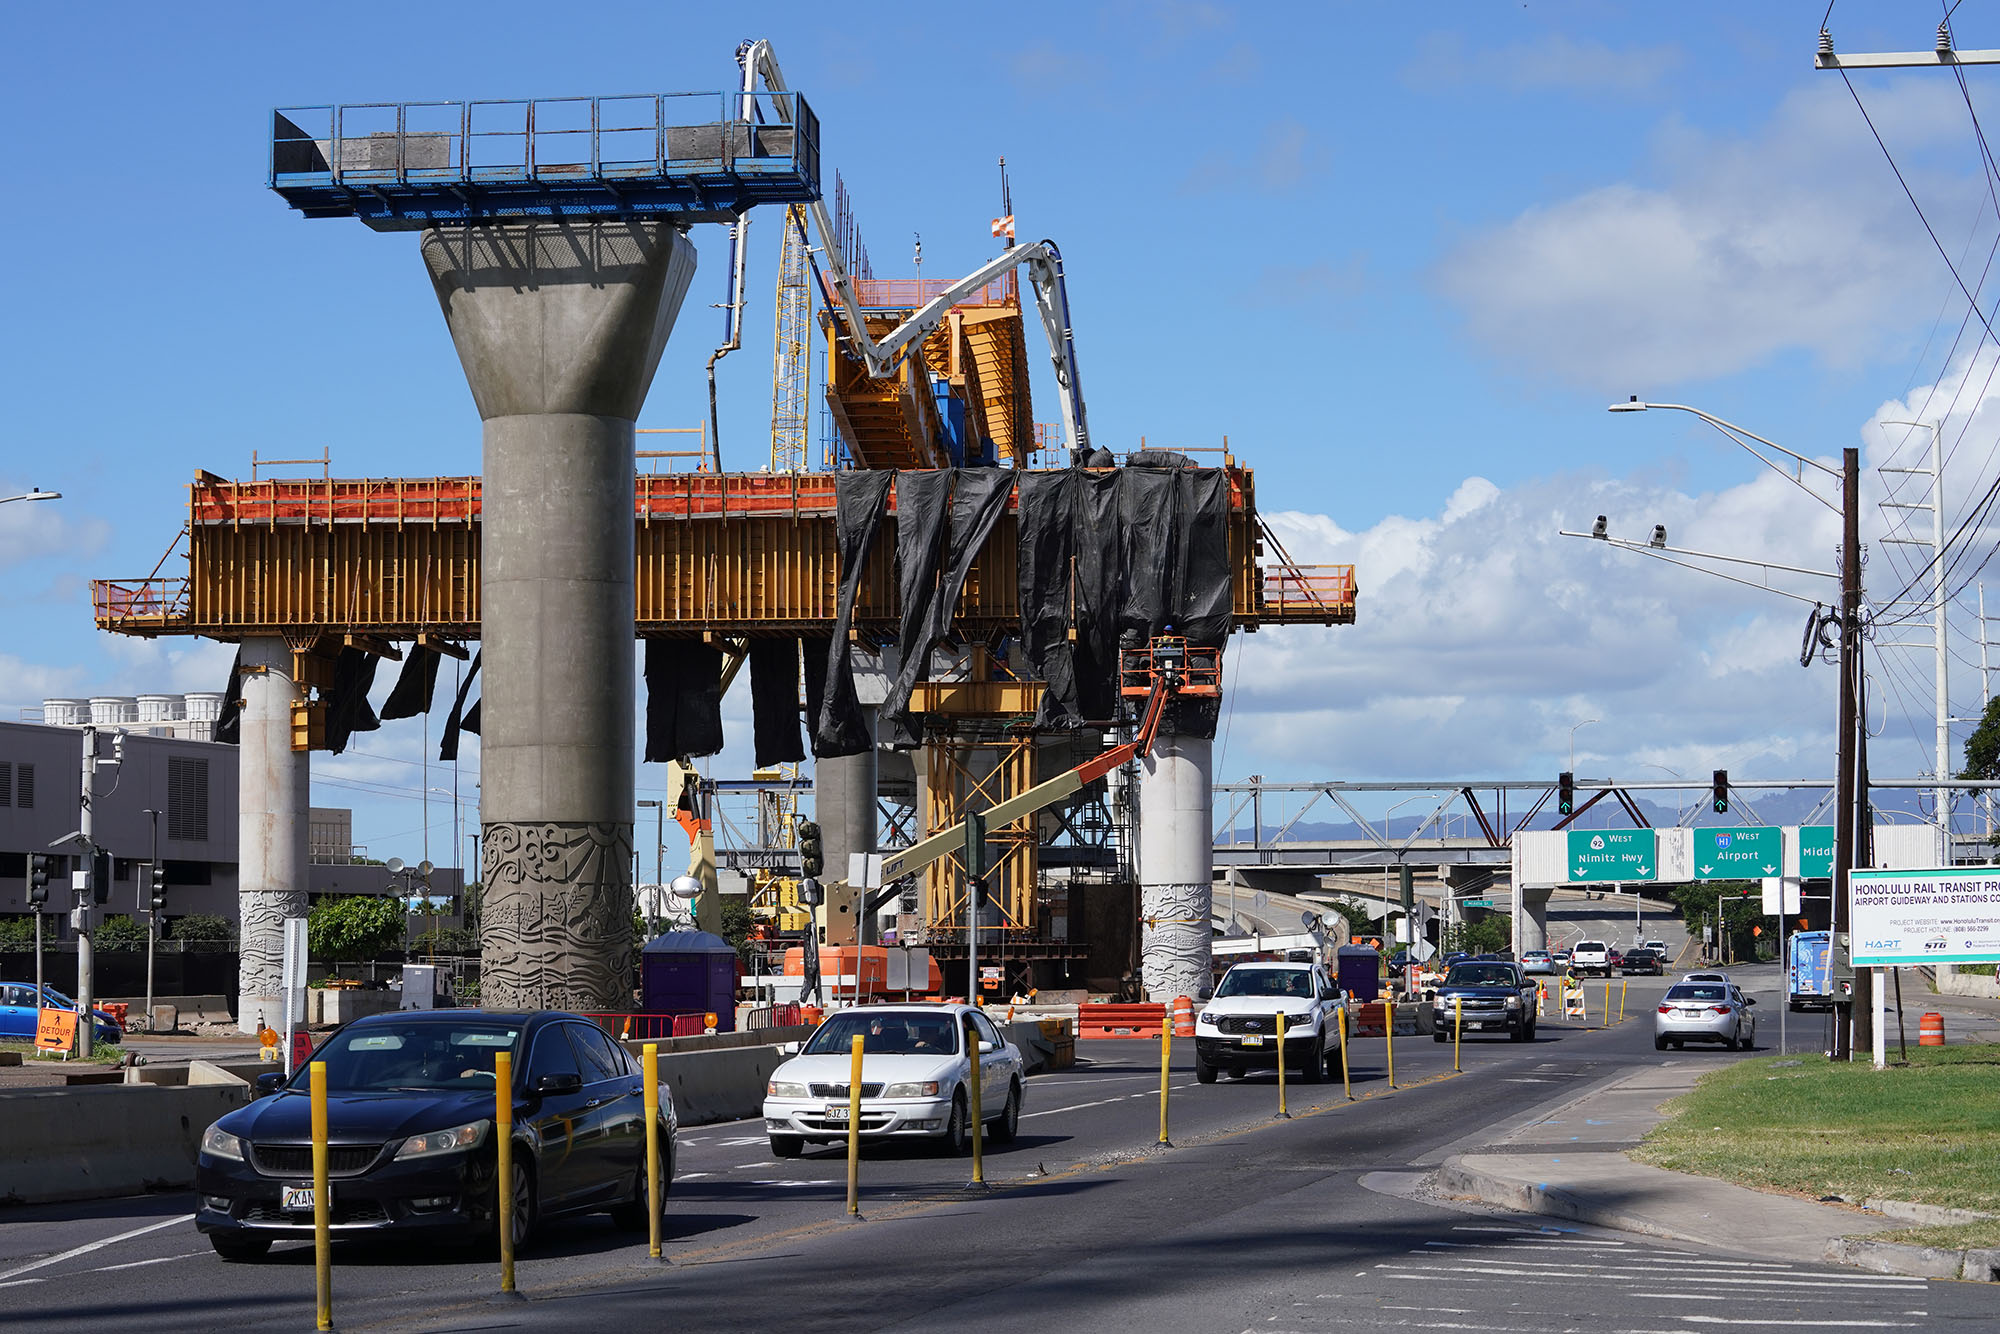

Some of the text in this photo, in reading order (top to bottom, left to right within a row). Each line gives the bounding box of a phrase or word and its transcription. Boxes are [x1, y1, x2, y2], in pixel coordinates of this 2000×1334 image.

[1592, 835, 1632, 848] 92 WEST
[1718, 838, 1728, 846] H1
[1736, 833, 1760, 841] WEST
[1578, 854, 1644, 863] Nimitz Hwy
[1717, 852, 1759, 861] Airport
[1803, 848, 1834, 857] Middl
[886, 859, 904, 875] LIFT
[1855, 882, 2000, 895] HONOLULU RAIL TRANSIT PR
[1855, 897, 1889, 906] AIRPORT
[1890, 896, 1931, 905] GUIDEWAY
[1932, 896, 1948, 904] AND
[1950, 895, 1988, 904] STATIONS
[41, 1026, 71, 1036] DETOUR
[287, 1191, 315, 1206] 2KAN
